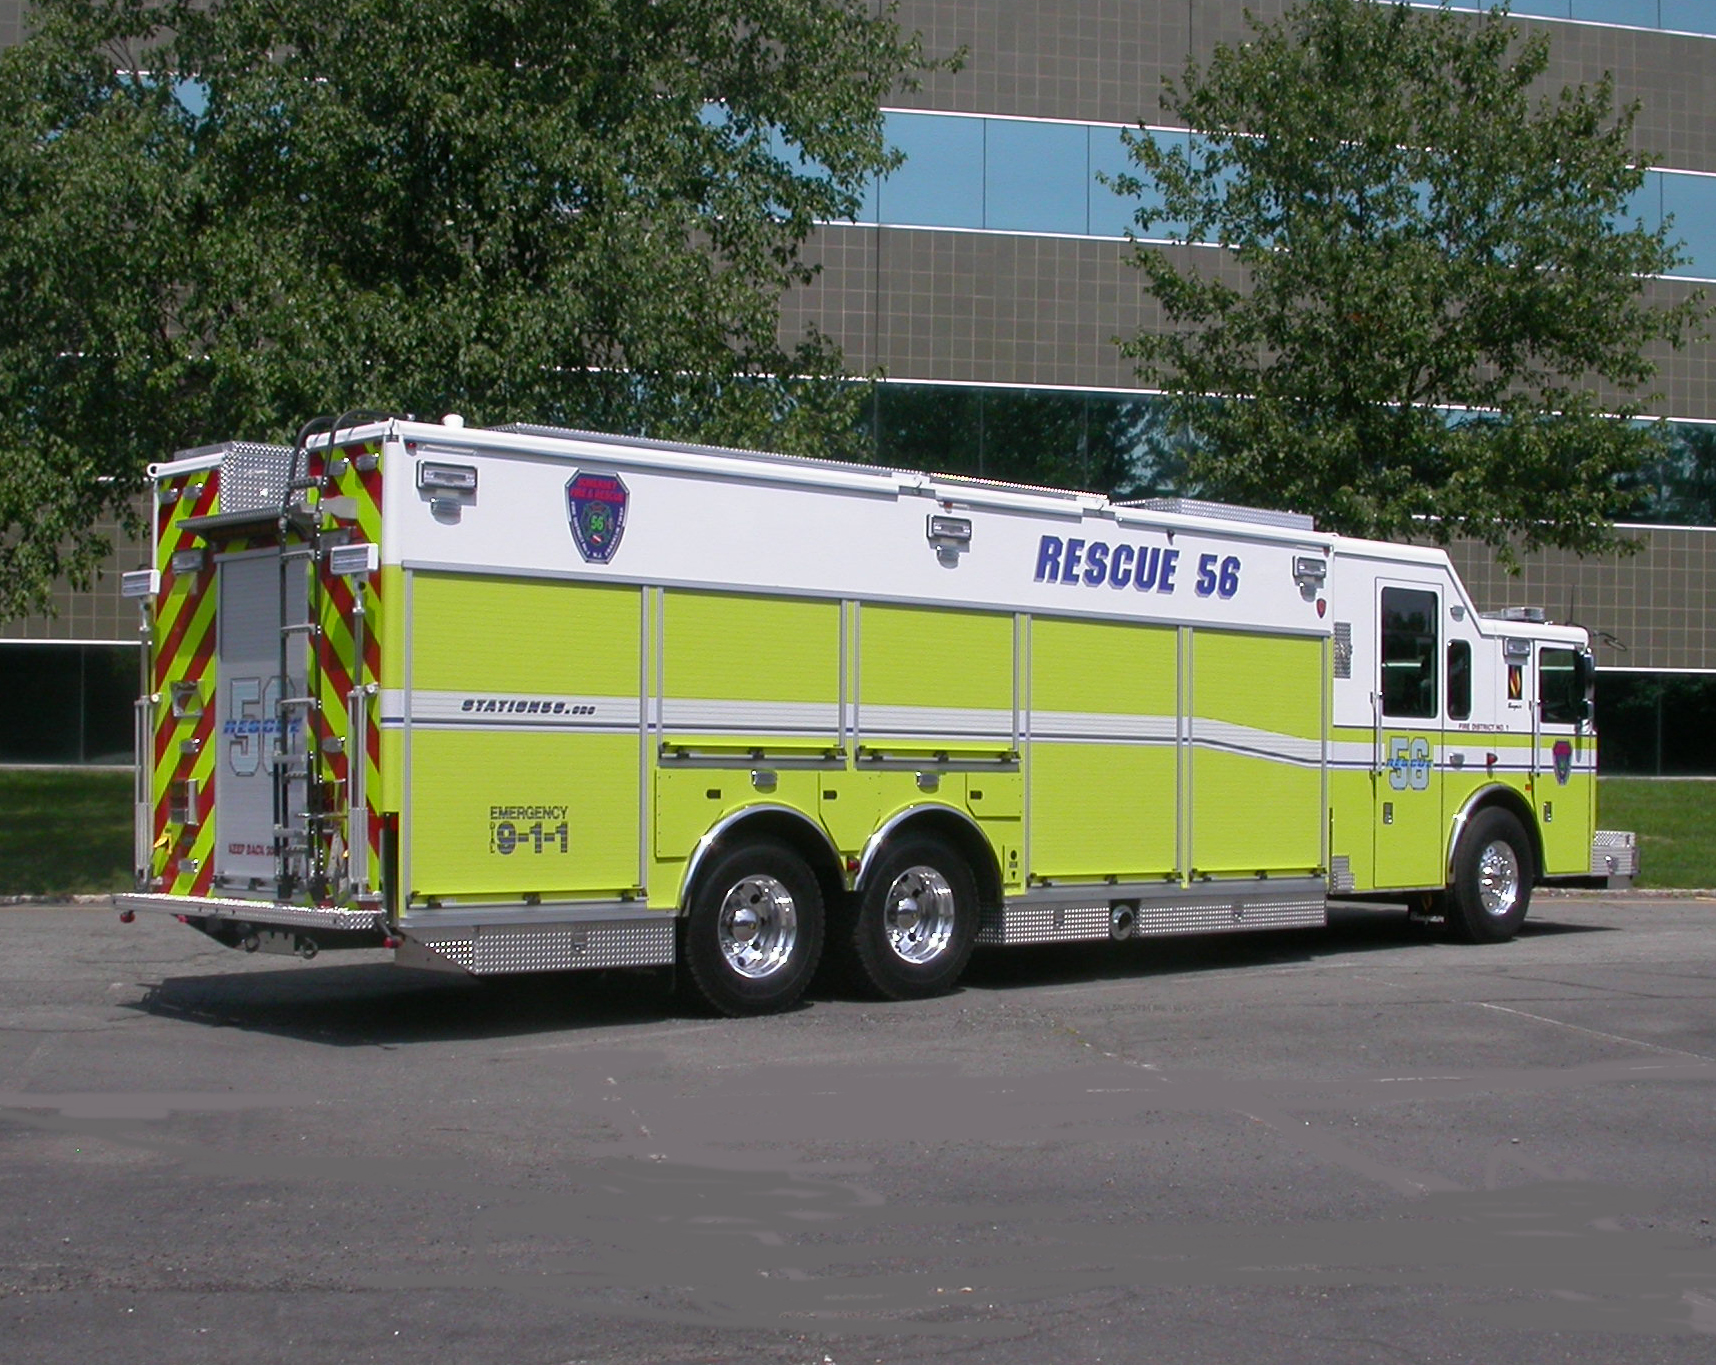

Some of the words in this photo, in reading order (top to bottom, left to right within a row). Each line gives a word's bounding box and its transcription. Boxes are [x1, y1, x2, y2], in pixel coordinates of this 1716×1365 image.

[594, 489, 624, 502] RESCUE
[590, 515, 604, 530] 56
[1033, 534, 1180, 594] RESCUE
[1194, 552, 1242, 600] 56
[1458, 722, 1470, 731] FIRE
[1472, 723, 1495, 731] DISTRICT
[1389, 736, 1430, 790] 56
[490, 805, 569, 820] EMERGENCY
[496, 821, 568, 855] 9-1-1
[228, 843, 245, 855] KEEP
